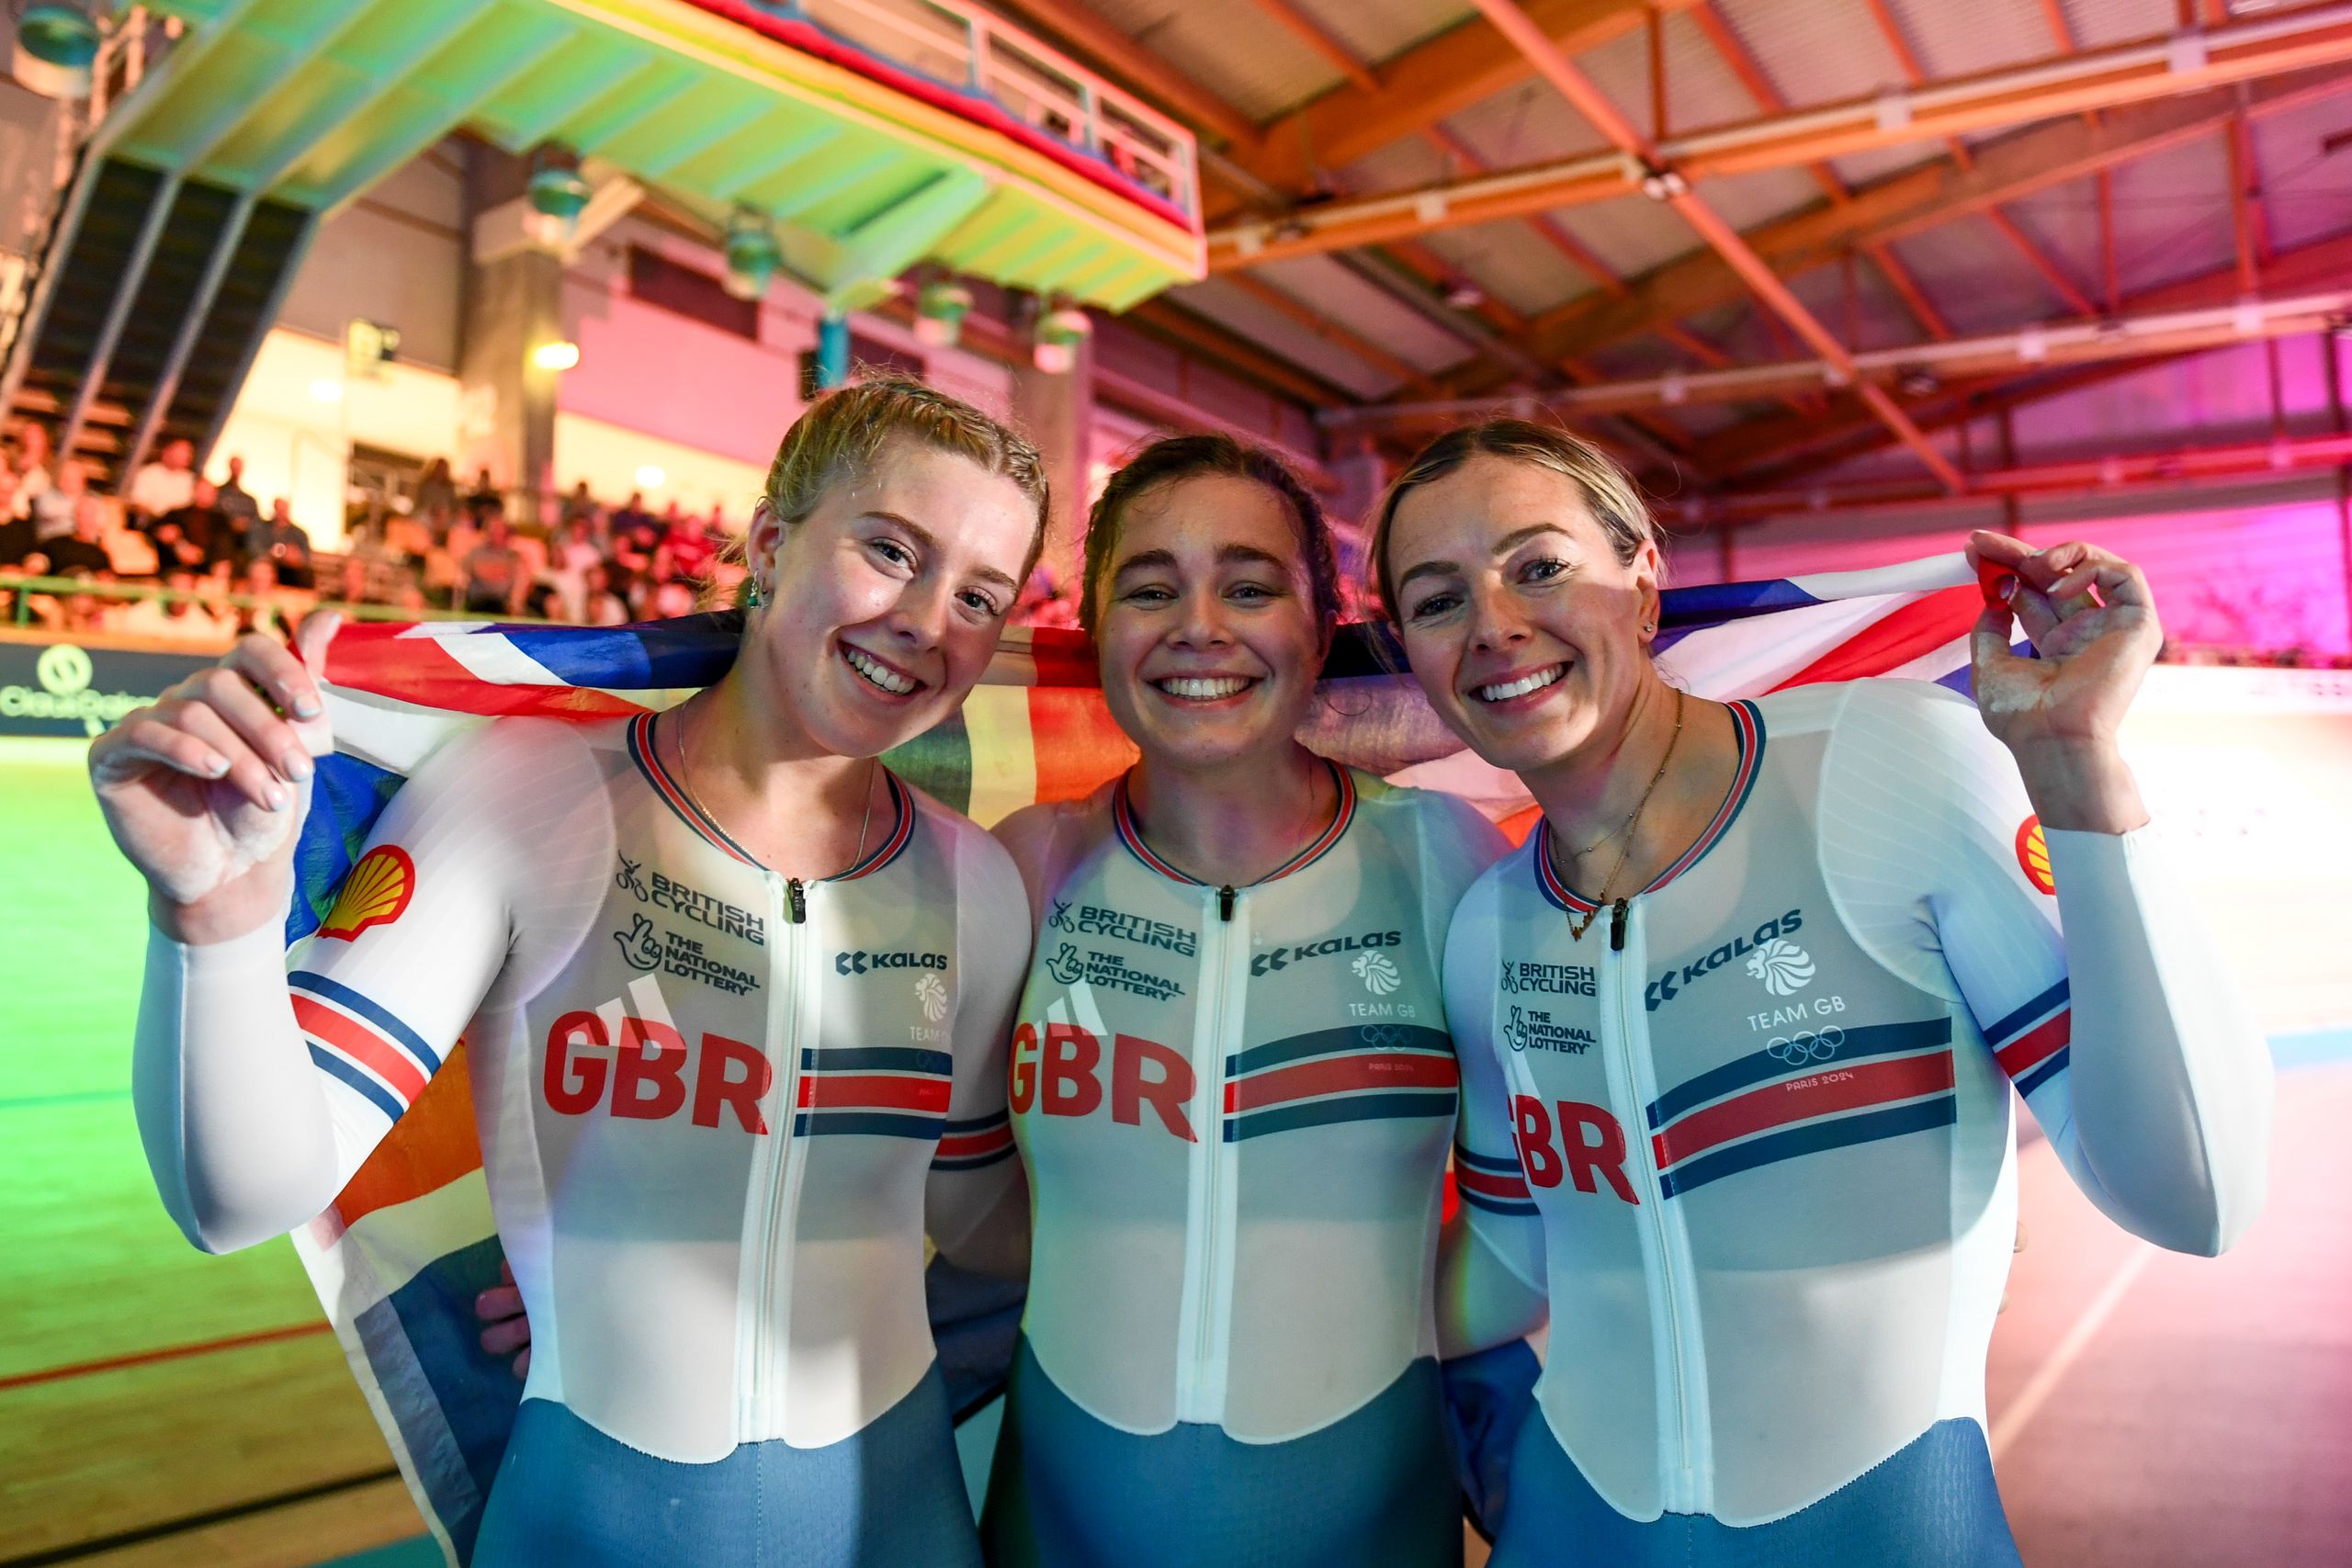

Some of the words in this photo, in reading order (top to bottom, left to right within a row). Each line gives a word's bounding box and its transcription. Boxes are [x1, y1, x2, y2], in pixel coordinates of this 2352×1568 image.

[651, 872, 764, 931] BRITISH
[651, 889, 764, 946] CYCLING
[1079, 920, 1195, 957] CYCLING
[1080, 906, 1196, 944] BRITISH
[665, 931, 703, 954] THE
[1088, 951, 1124, 966] THE
[664, 960, 751, 996] LOTTERY
[665, 946, 761, 988] NATIONAL
[1086, 963, 1185, 996] NATIONAL
[1520, 963, 1595, 981] BRITISH
[1085, 974, 1175, 1001] LOTTERY
[1520, 977, 1596, 997] CYCLING
[1349, 1003, 1393, 1016] TEAM
[1396, 1004, 1416, 1018] GB
[1528, 1010, 1551, 1023] THE
[1747, 1003, 1808, 1032] TEAM
[1814, 996, 1846, 1014] GB
[1528, 1023, 1596, 1043] NATIONAL
[1529, 1036, 1589, 1055] LOTTERY
[543, 1010, 773, 1135] GBR
[1010, 1021, 1198, 1143] GBR
[1785, 1079, 1818, 1092] PARIS
[1822, 1072, 1853, 1085] 2024
[1508, 1094, 1640, 1205] BR
